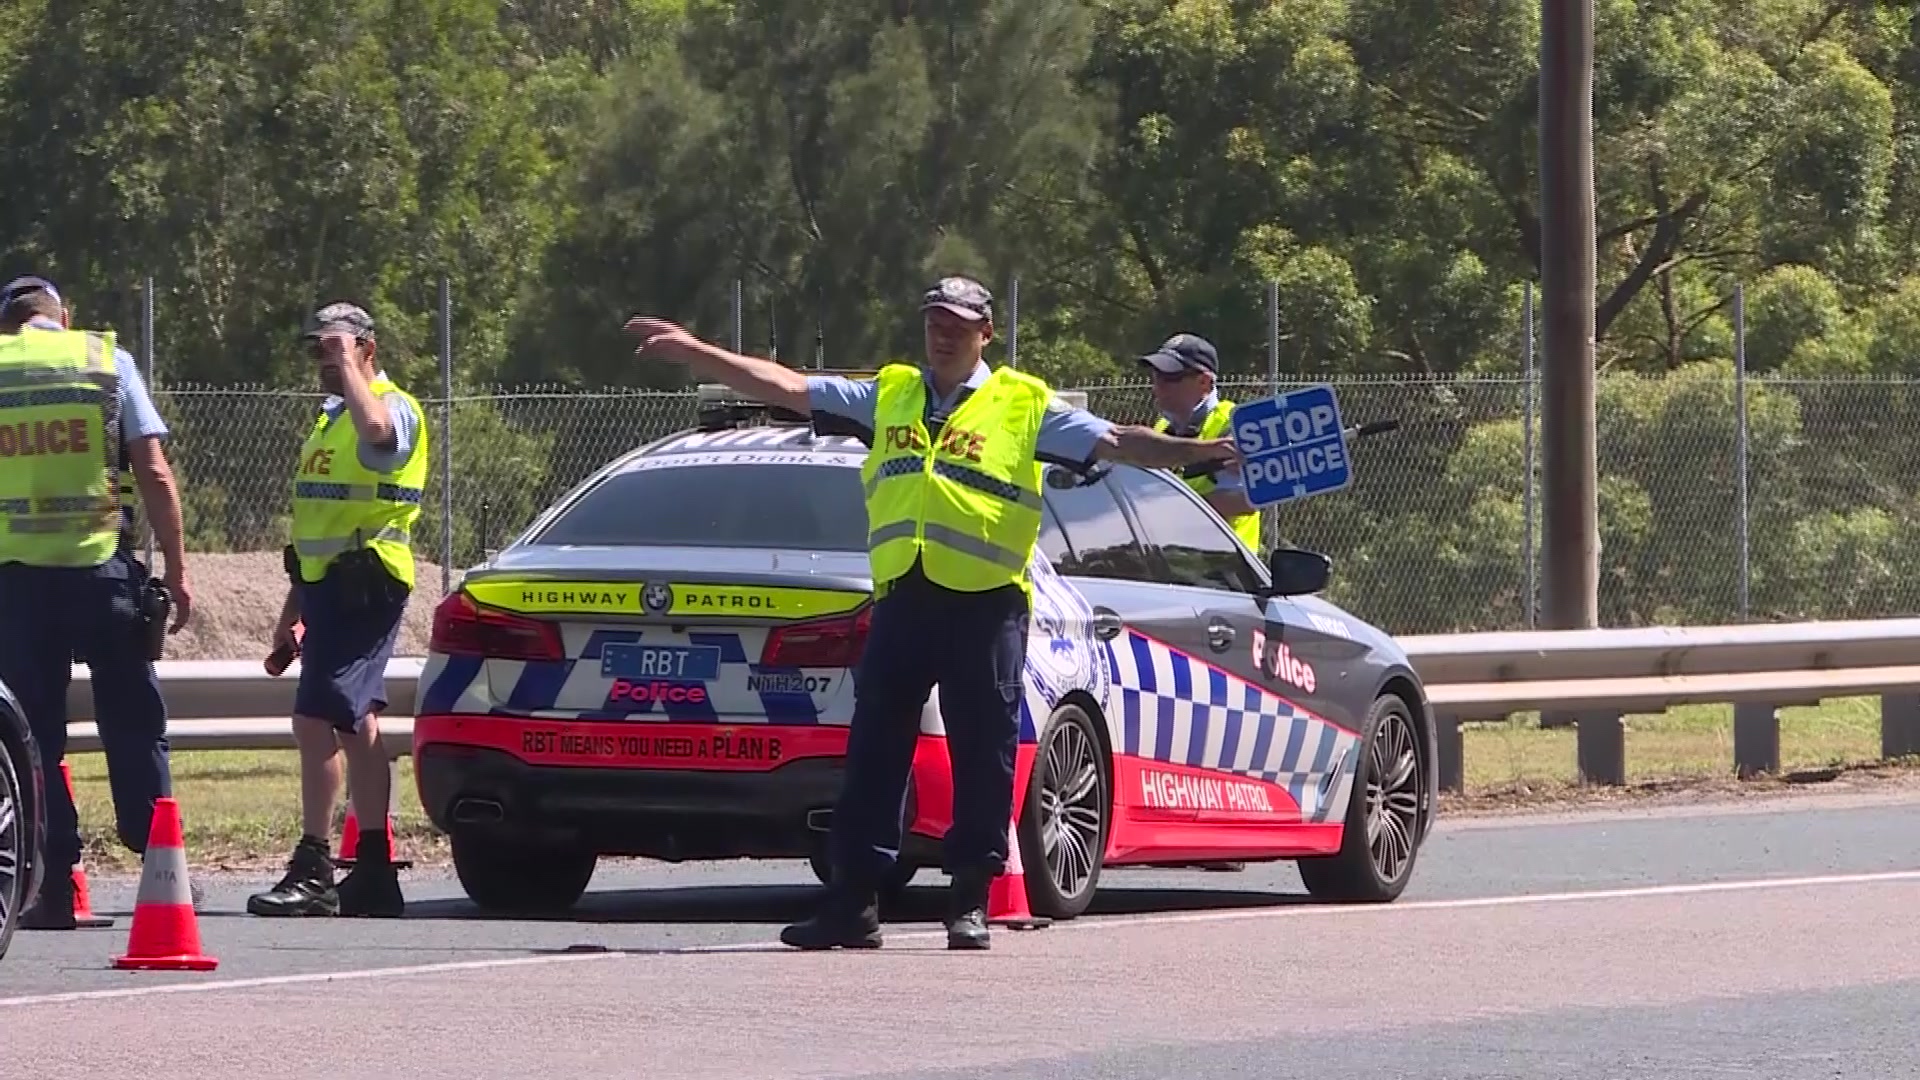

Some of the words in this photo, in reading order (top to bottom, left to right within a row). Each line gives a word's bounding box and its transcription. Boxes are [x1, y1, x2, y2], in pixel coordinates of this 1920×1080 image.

[885, 426, 986, 462] POLICE
[1239, 405, 1334, 453] STOP
[731, 454, 813, 463] Drink
[1245, 442, 1344, 488] POLICE
[522, 591, 627, 605] HIGHWAY
[686, 594, 776, 609] PATROL
[641, 650, 690, 676] RBT
[1252, 629, 1316, 693] Police
[610, 680, 706, 703] Police
[522, 731, 558, 753] RBT
[561, 736, 615, 756] MEANS
[618, 737, 649, 757] YOU
[654, 738, 693, 757] NEED
[699, 740, 708, 758] A
[713, 736, 763, 760] PLAN
[769, 738, 781, 761] B
[1140, 769, 1224, 809] HIGHWAY
[1225, 780, 1273, 811] PATROL
